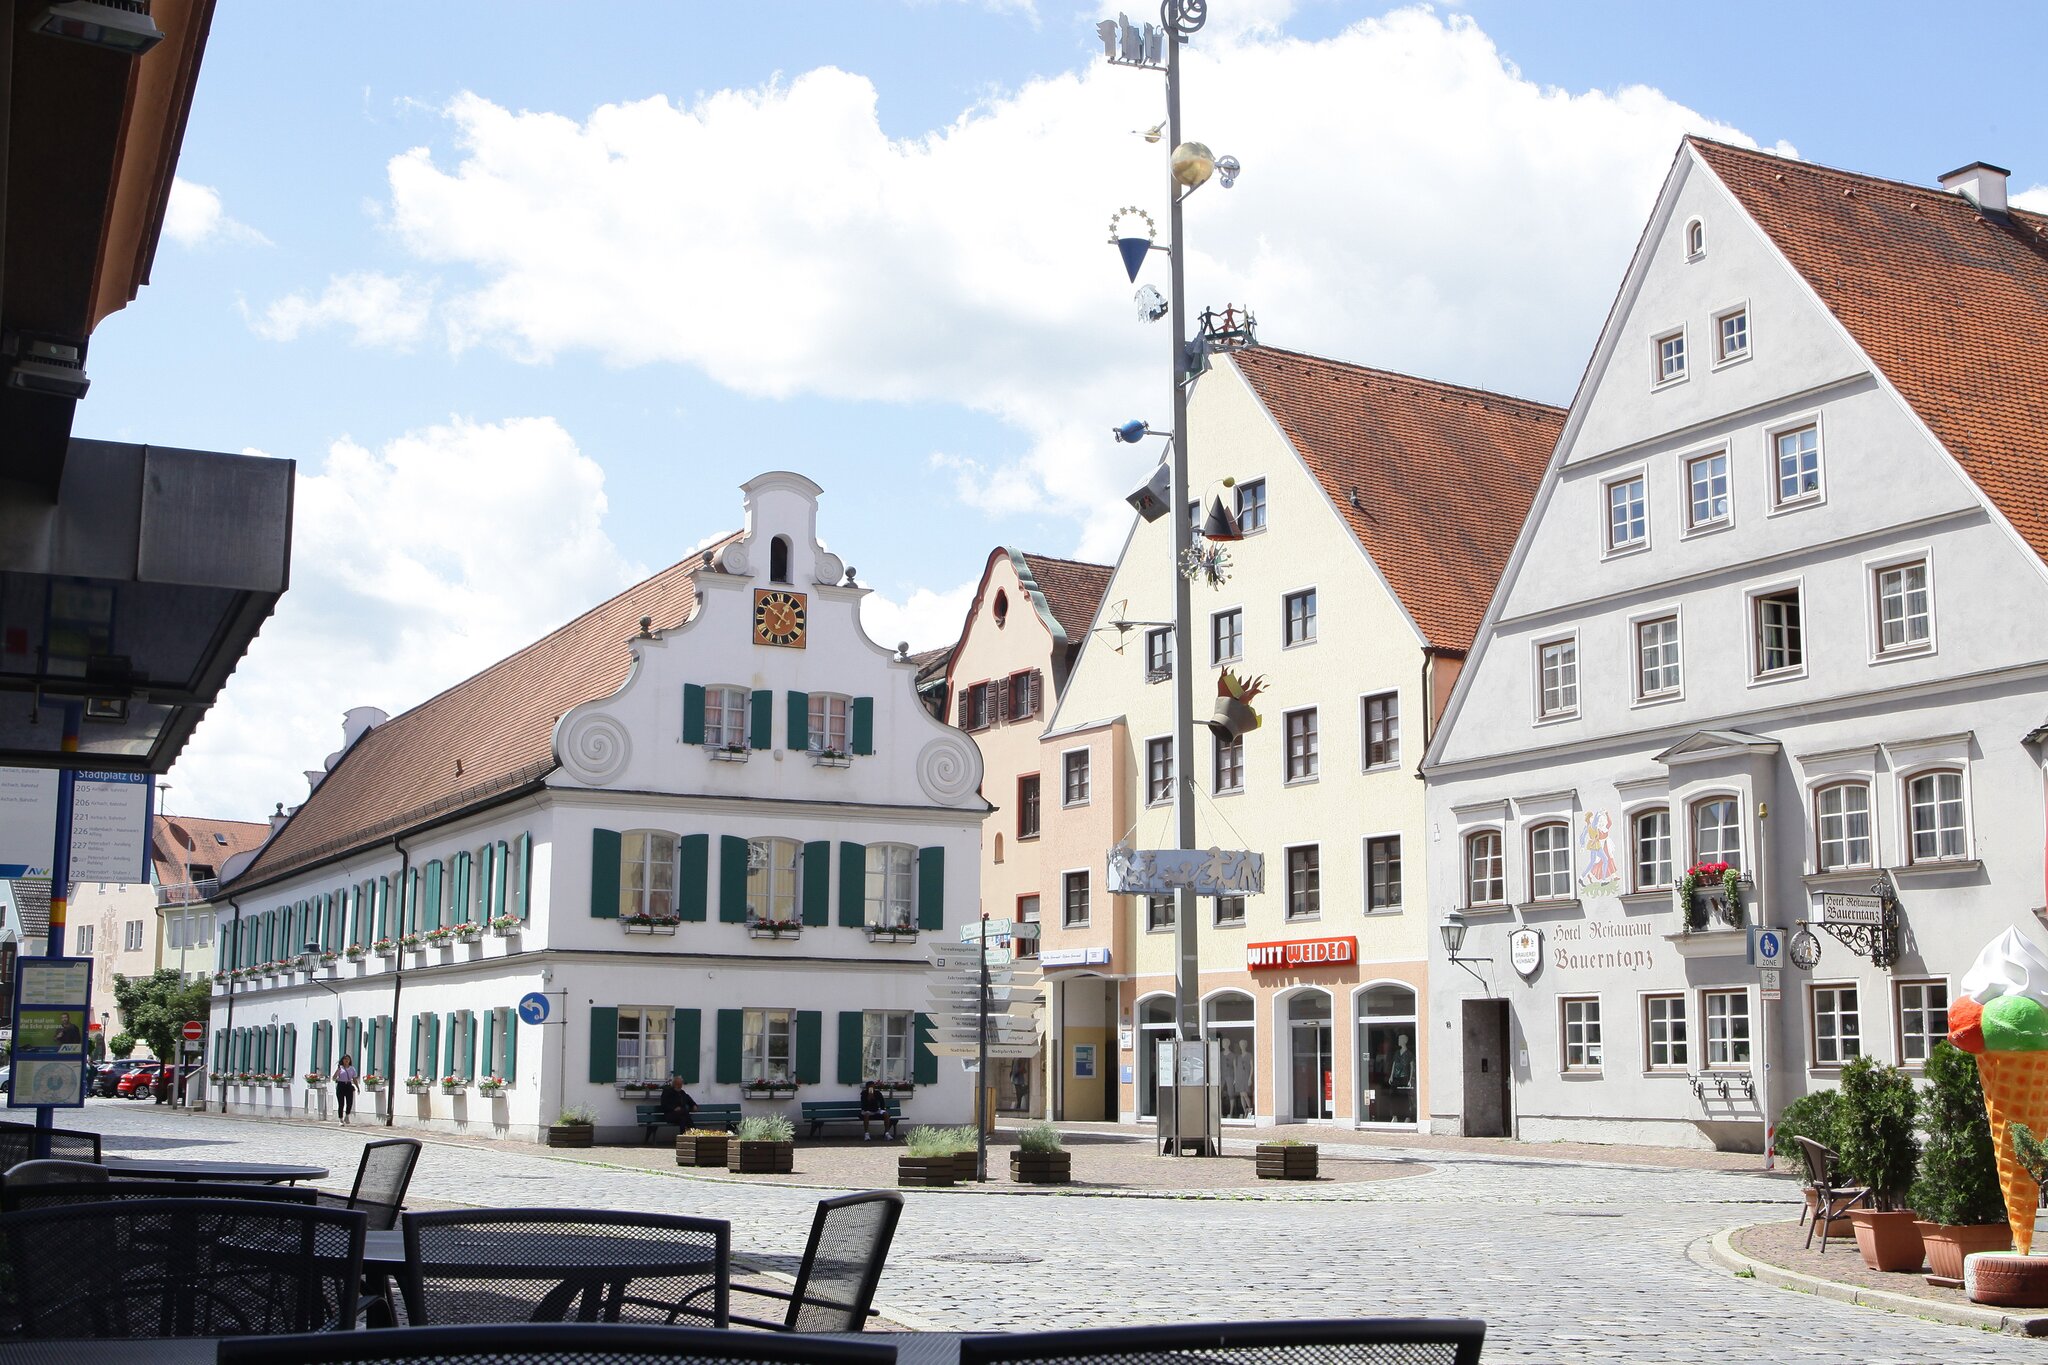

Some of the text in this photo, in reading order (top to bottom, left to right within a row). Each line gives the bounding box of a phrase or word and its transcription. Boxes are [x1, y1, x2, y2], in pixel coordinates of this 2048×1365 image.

[79, 770, 127, 781] Stadtplatz
[70, 870, 85, 878] 228
[1826, 896, 1844, 906] Hotel
[1827, 906, 1880, 923] Bauerntanz
[1553, 920, 1652, 942] Hotel Restaurant
[1247, 941, 1350, 965] WITT WEIDEN
[1554, 948, 1653, 970] Bauerntanz
